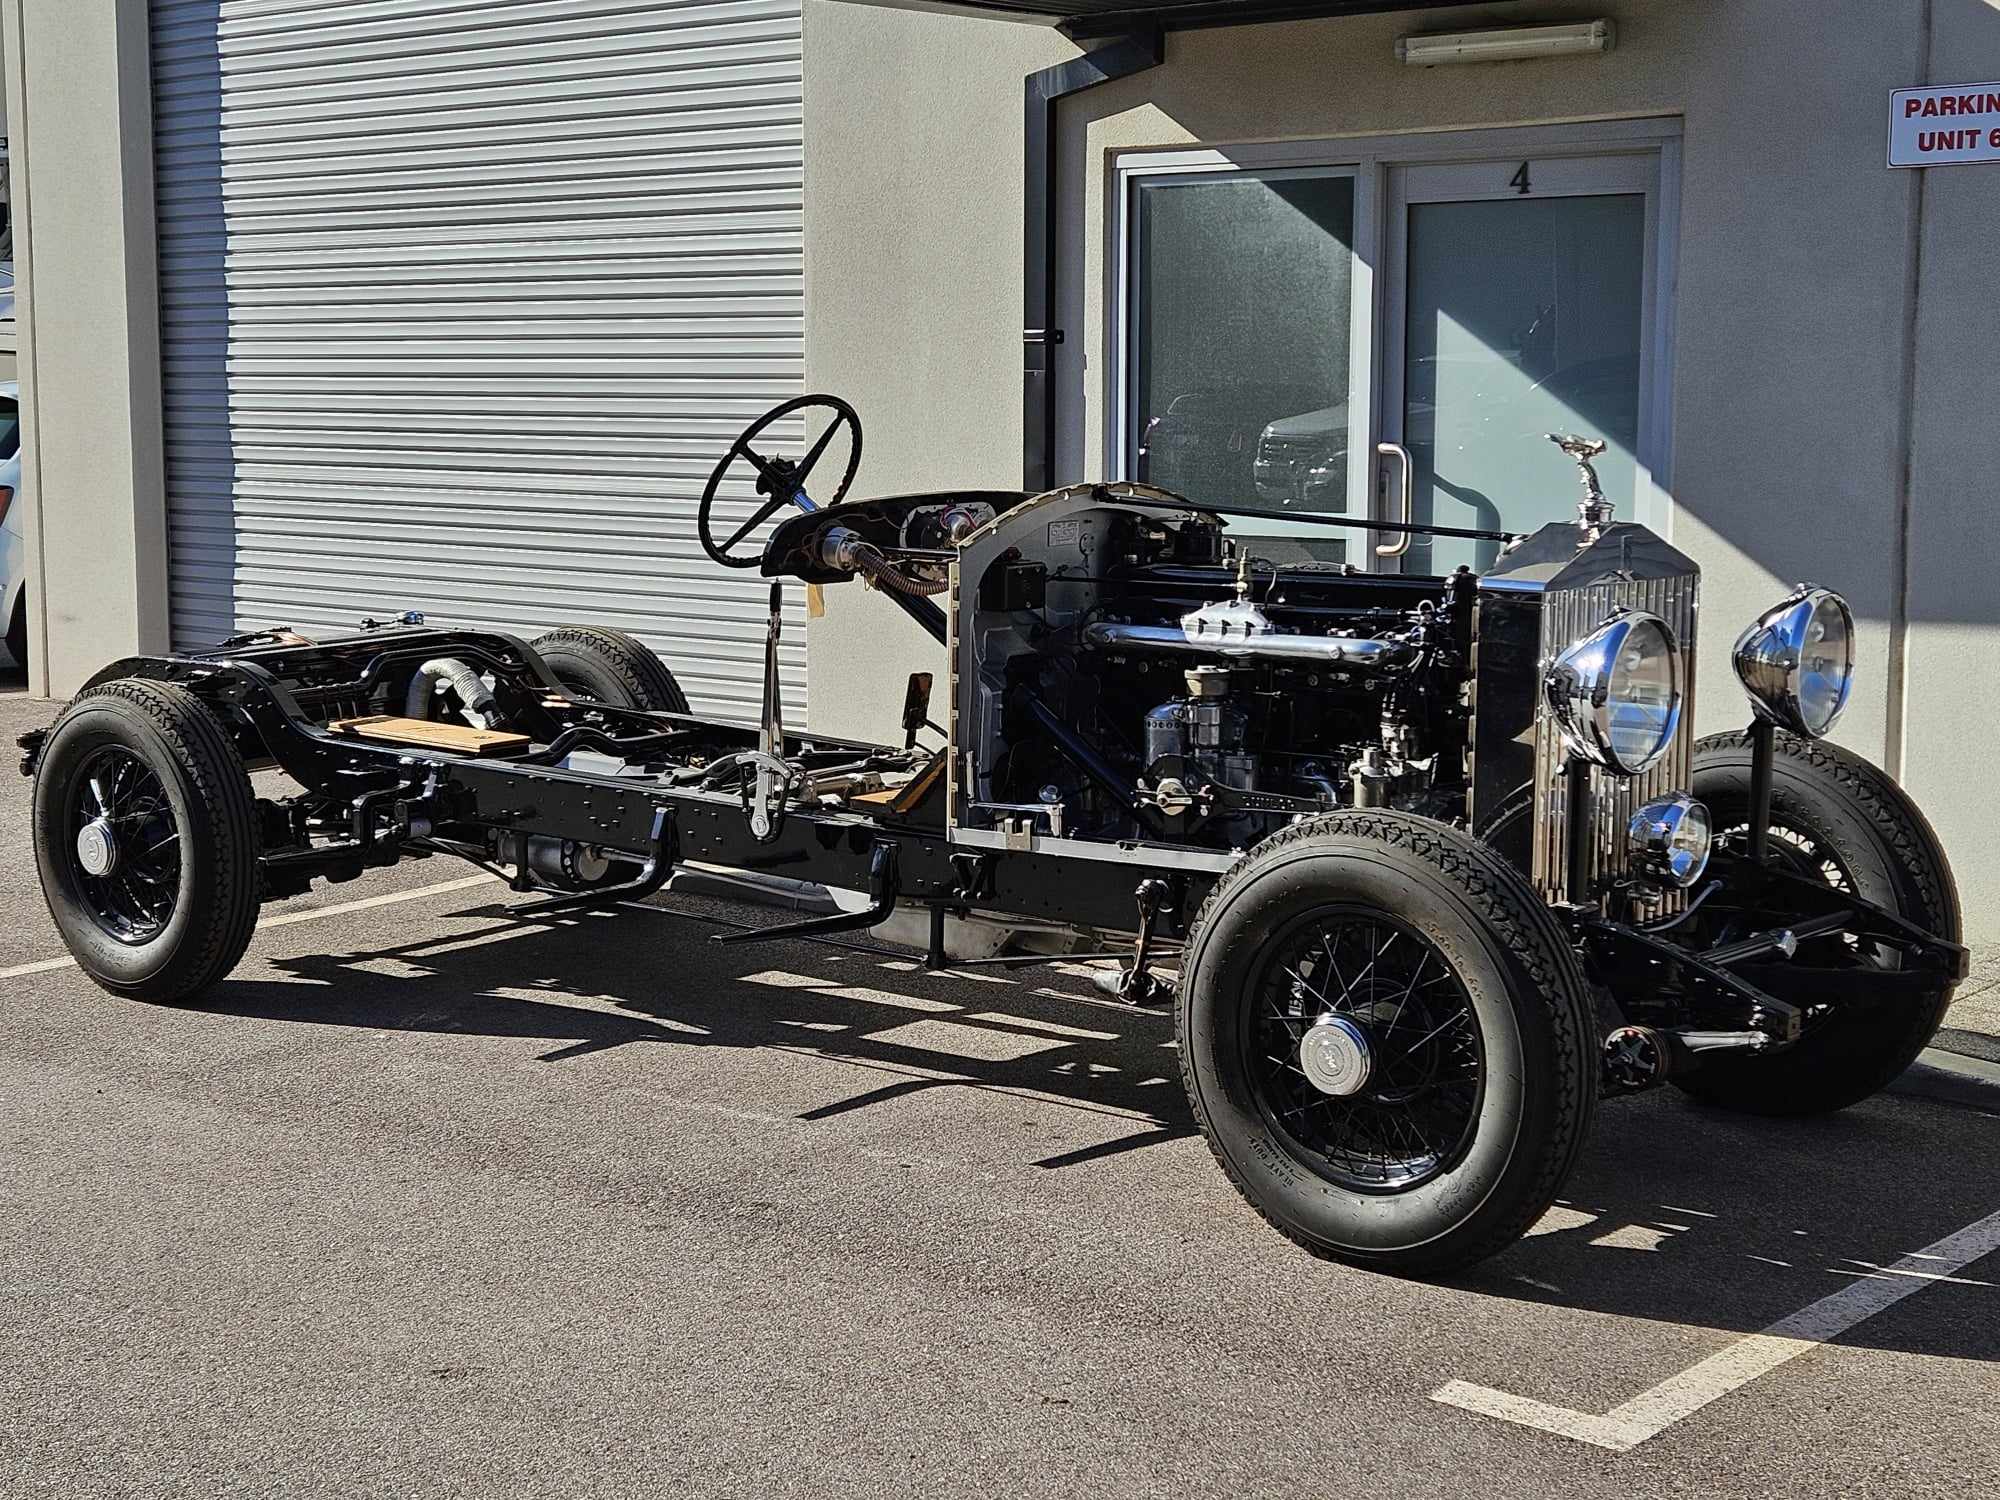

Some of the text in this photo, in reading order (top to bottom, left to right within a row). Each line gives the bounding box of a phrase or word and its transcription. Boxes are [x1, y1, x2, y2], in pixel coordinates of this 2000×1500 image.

[1905, 93, 2000, 118] PARKIN
[1918, 129, 1981, 151] UNIT
[1509, 160, 1532, 194] 4
